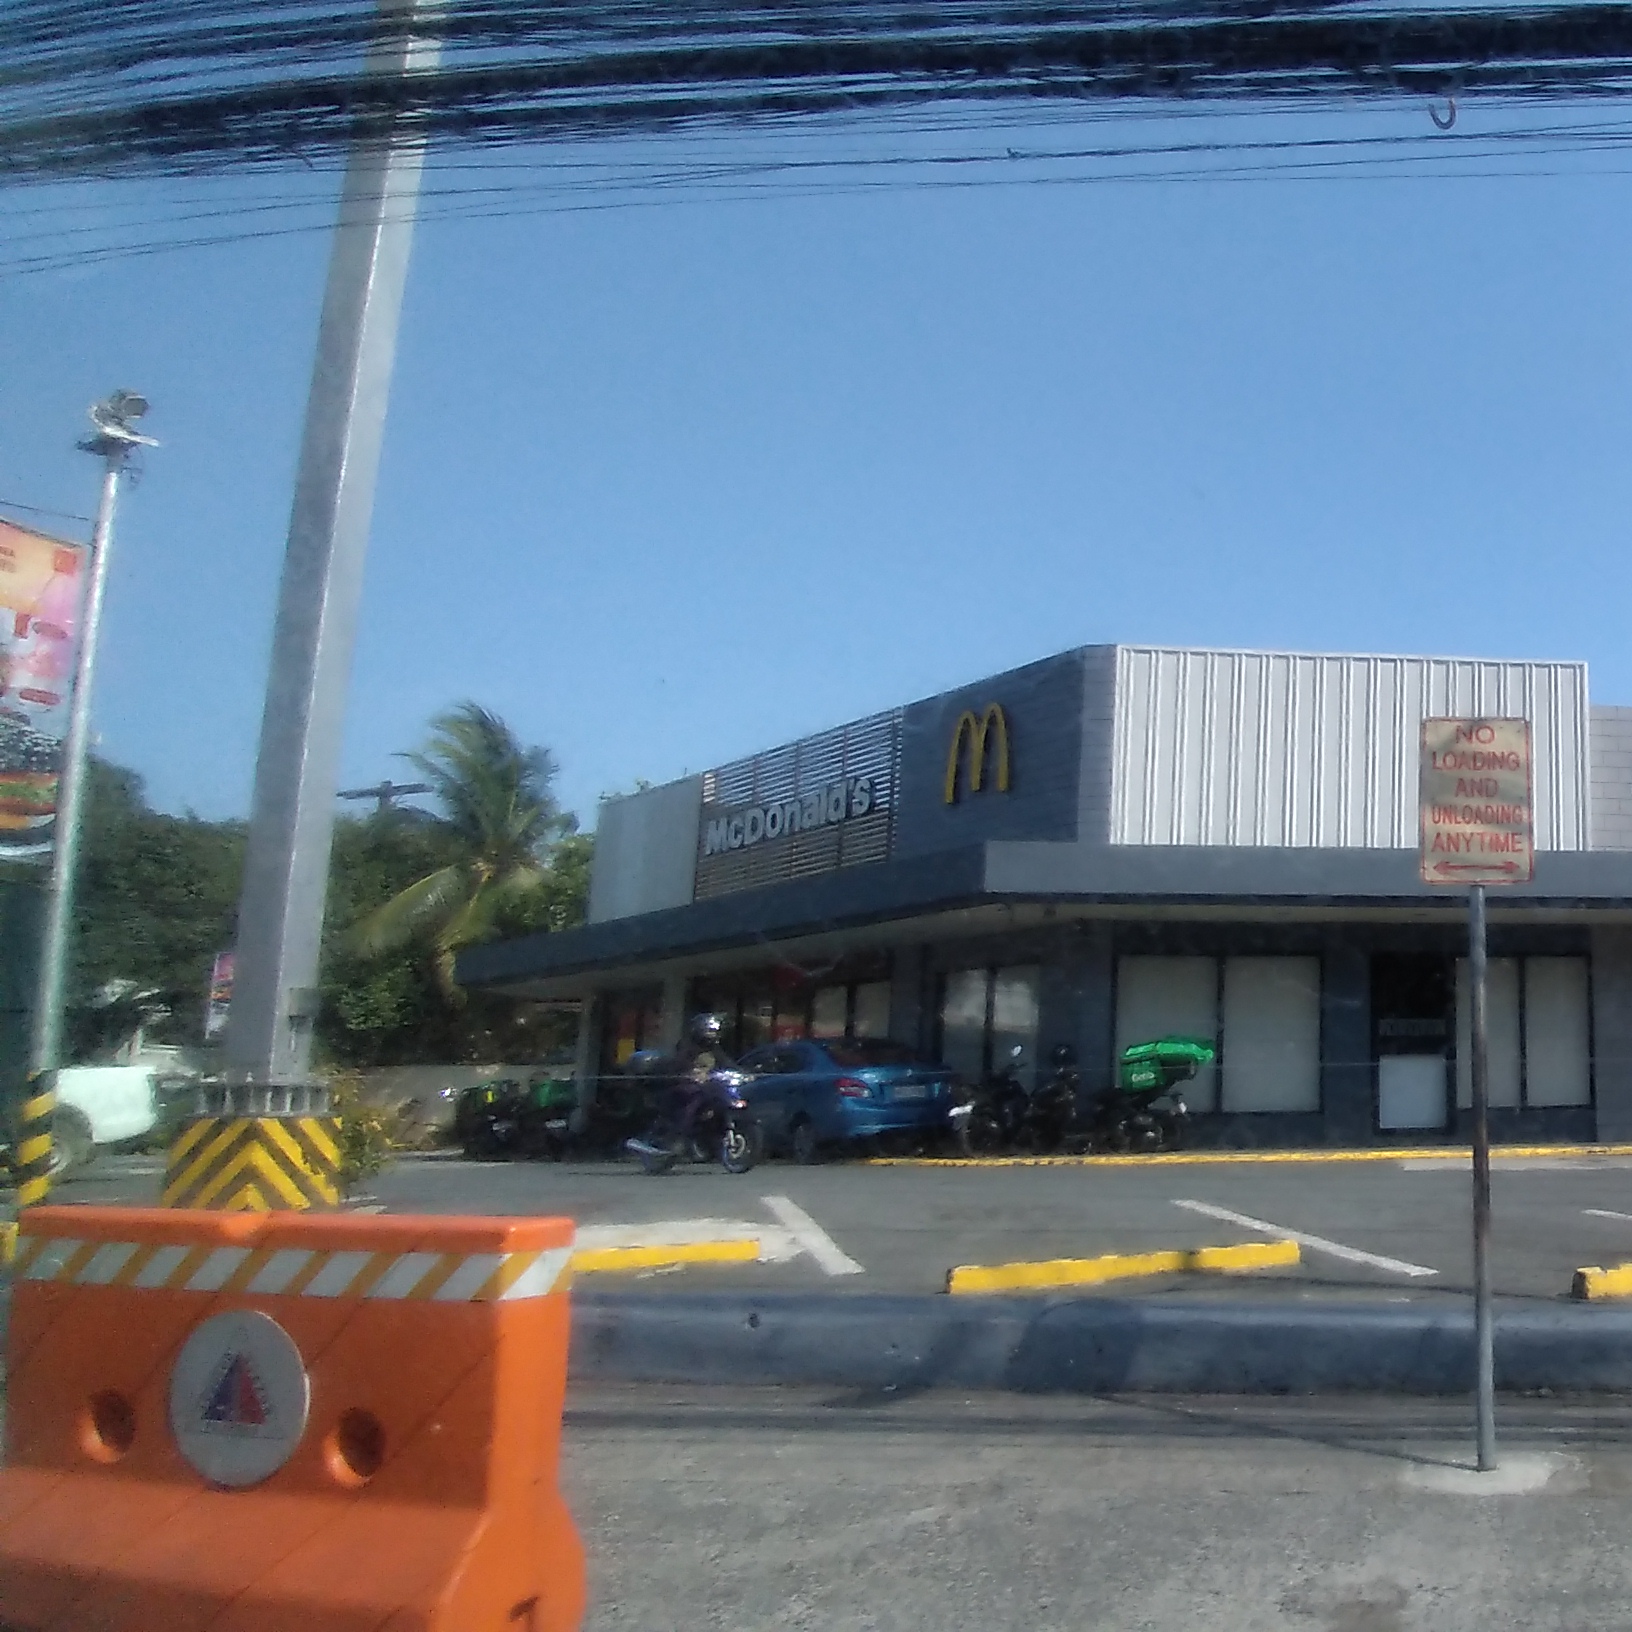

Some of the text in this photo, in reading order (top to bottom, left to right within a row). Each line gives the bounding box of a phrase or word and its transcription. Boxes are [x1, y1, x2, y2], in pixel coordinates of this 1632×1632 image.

[1455, 725, 1495, 745] NO
[1432, 751, 1521, 772] LOADING
[1454, 778, 1499, 798] AND
[704, 776, 875, 856] McDonald's
[1431, 805, 1524, 825] UNLOADING
[1430, 832, 1524, 853] ANYTIME
